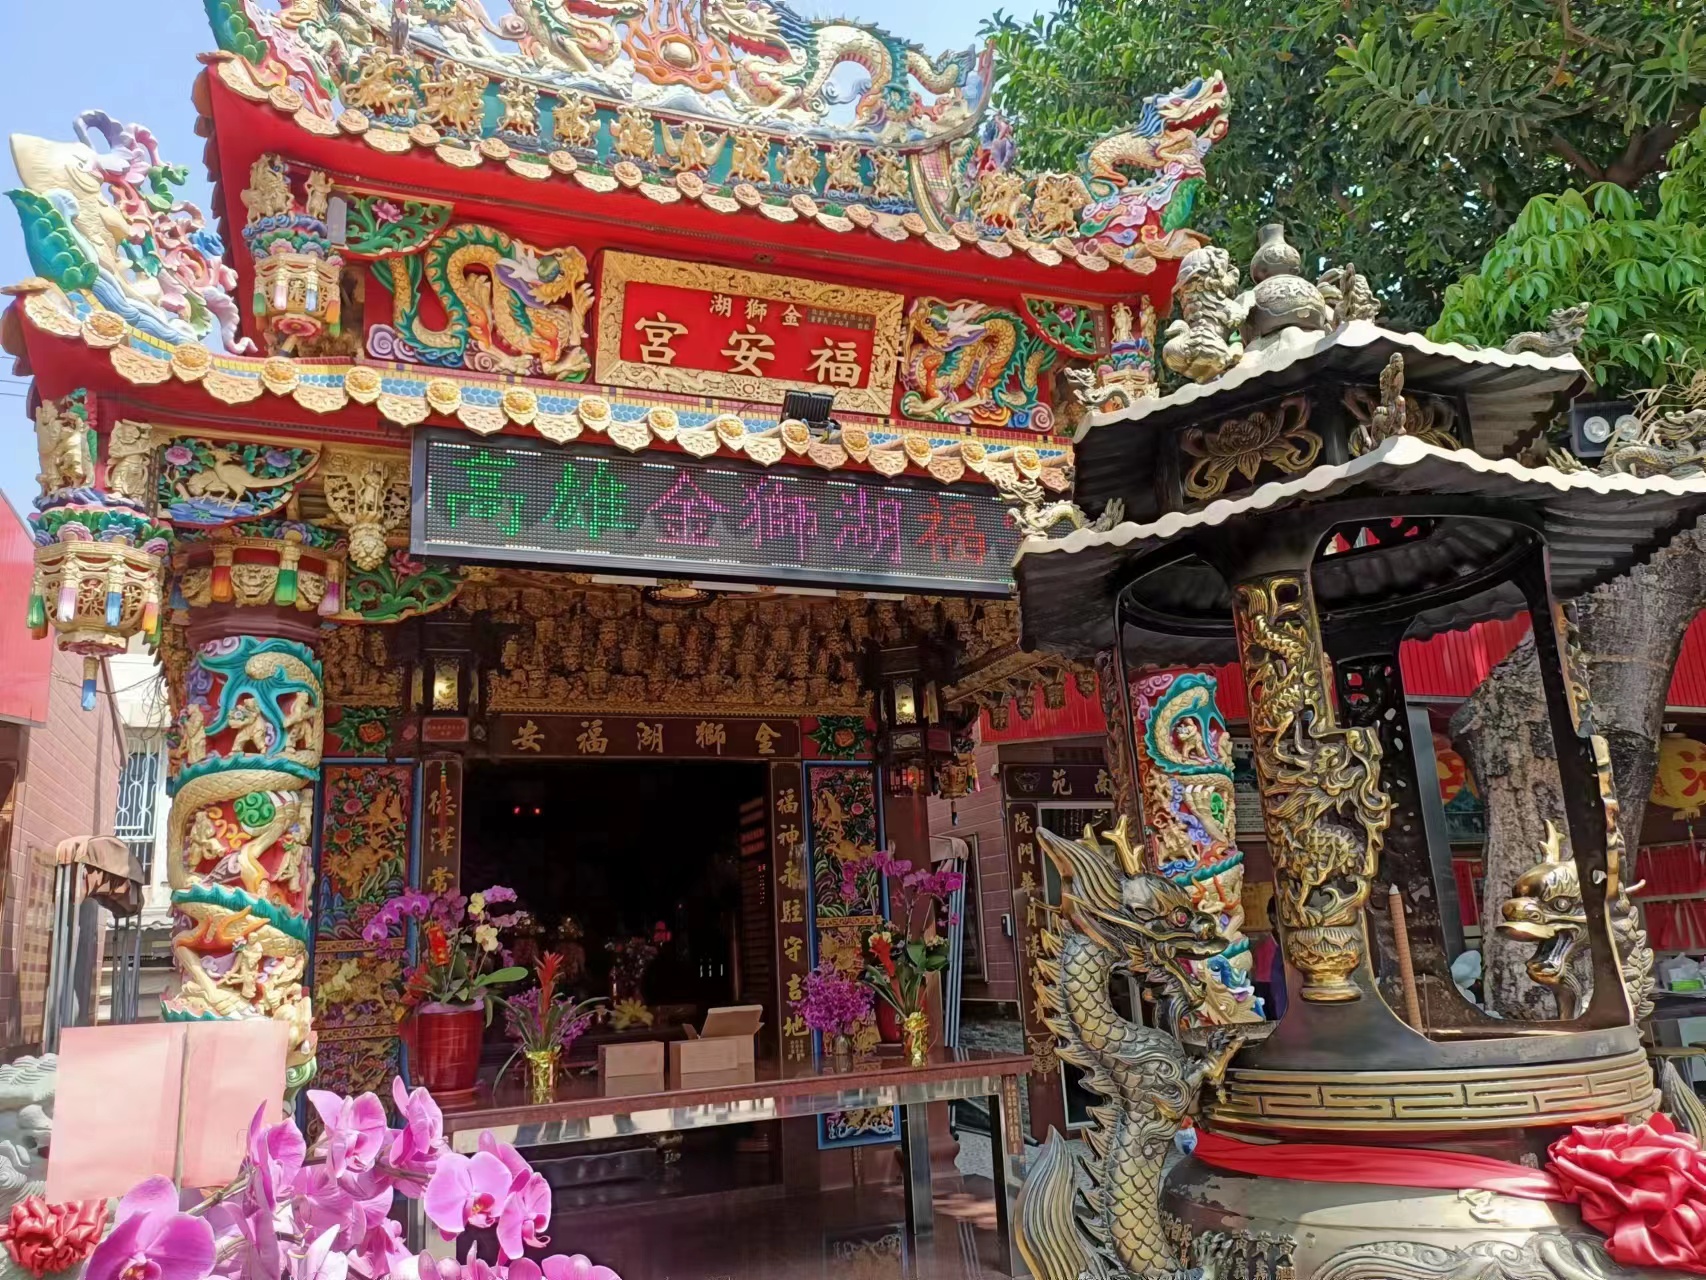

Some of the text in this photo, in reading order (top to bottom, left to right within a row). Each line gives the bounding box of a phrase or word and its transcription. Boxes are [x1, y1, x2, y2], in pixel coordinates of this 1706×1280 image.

[709, 294, 802, 327] 金獅湖
[634, 311, 863, 388] 福安宮
